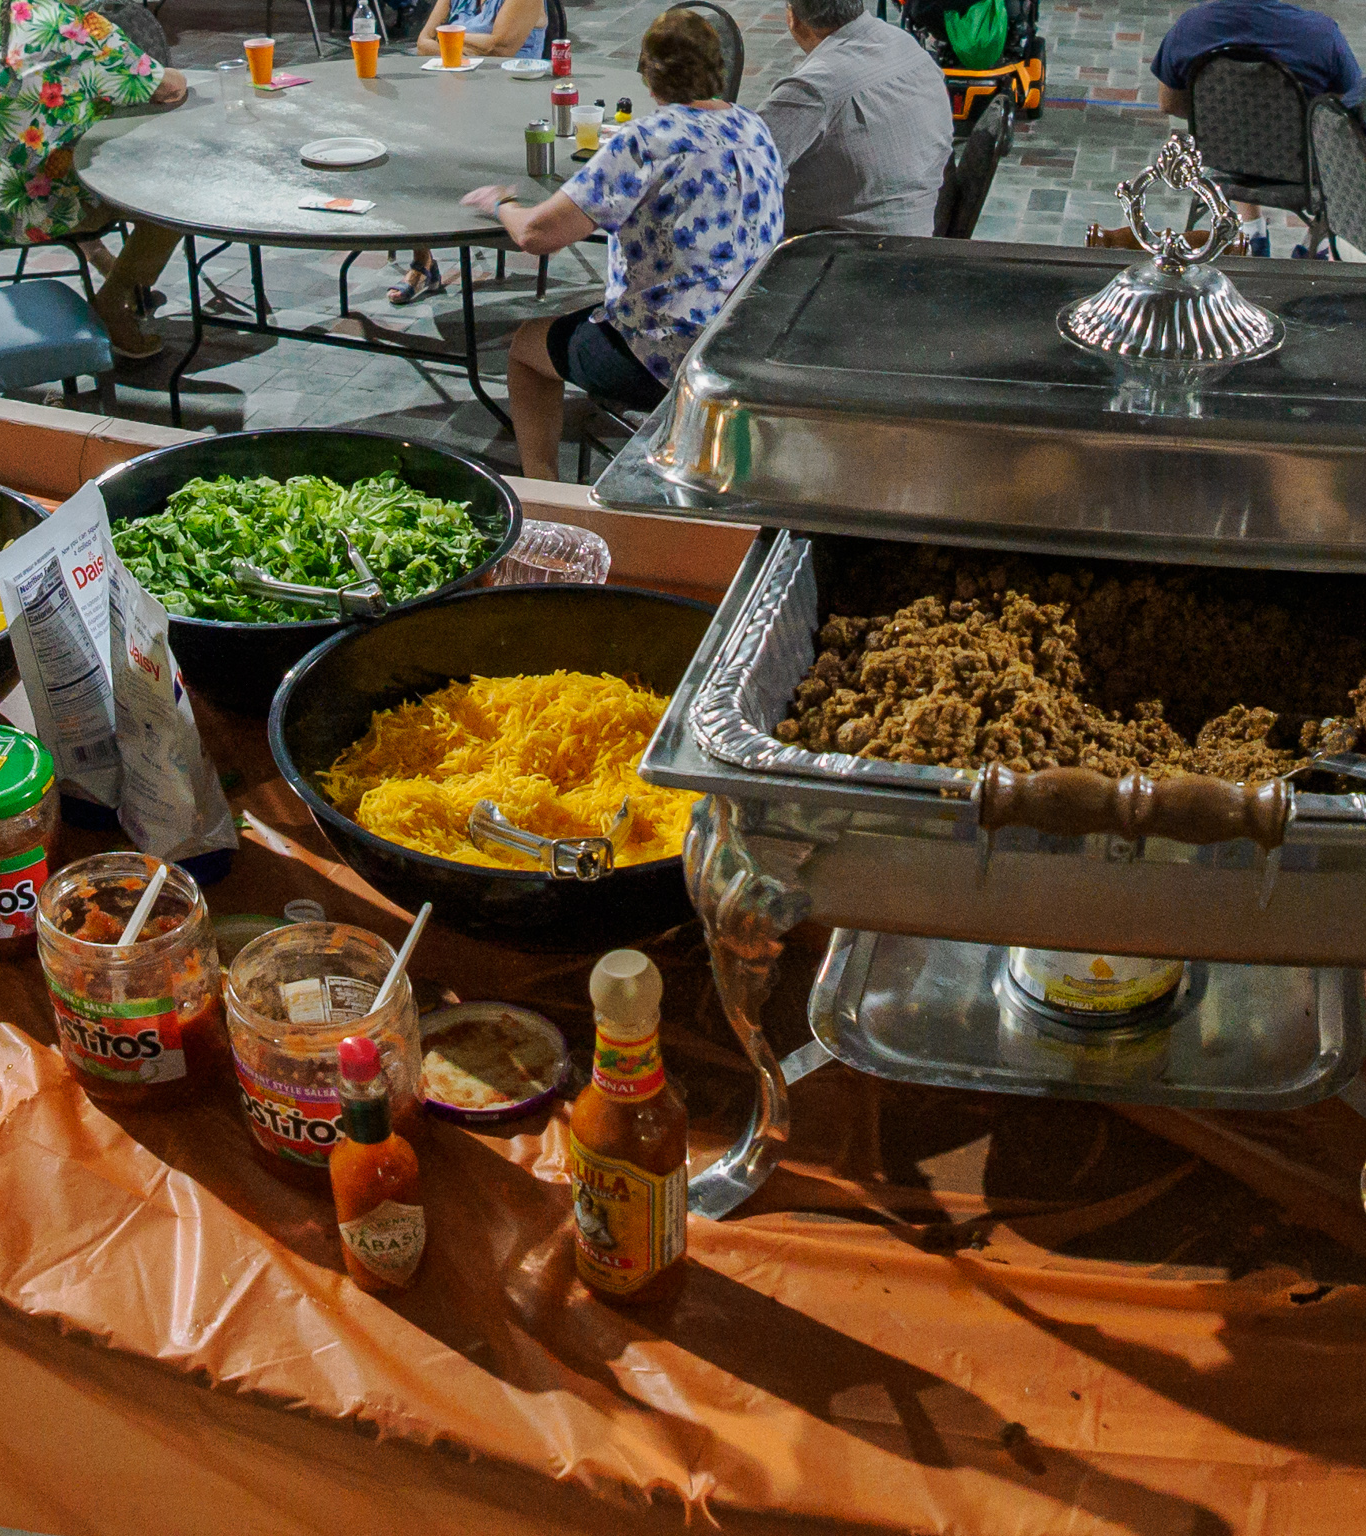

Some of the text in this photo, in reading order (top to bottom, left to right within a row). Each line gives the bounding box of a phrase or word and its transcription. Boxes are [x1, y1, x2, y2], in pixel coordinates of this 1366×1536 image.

[70, 538, 78, 550] you
[78, 530, 87, 541] can
[19, 571, 43, 594] Nutrition
[43, 559, 57, 575] Facts
[71, 554, 104, 590] Dais
[82, 1001, 114, 1015] SALSA
[272, 1080, 302, 1096] STYLE
[303, 1088, 338, 1098] SALSA
